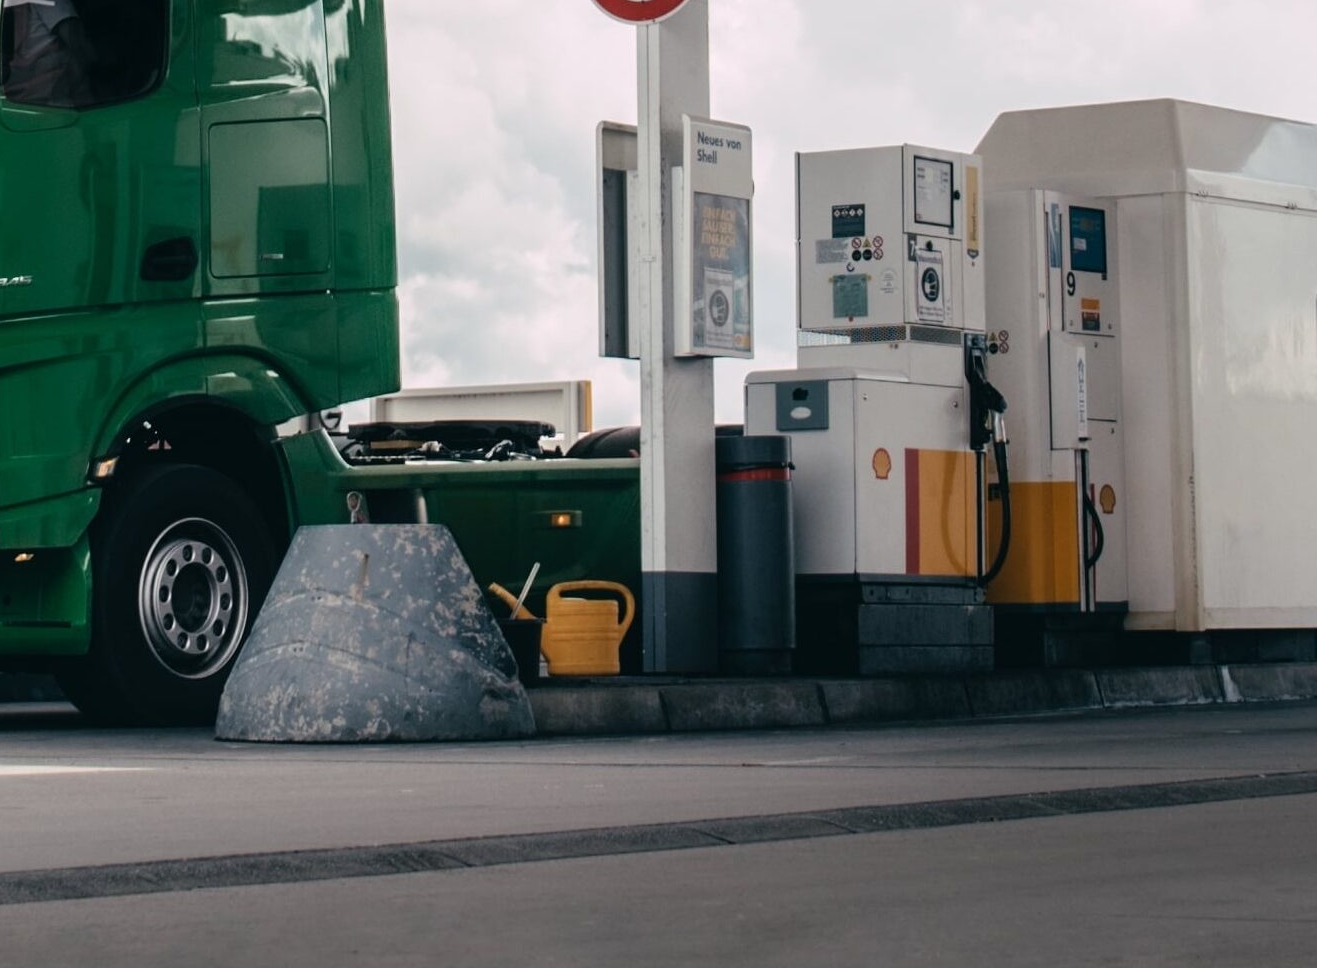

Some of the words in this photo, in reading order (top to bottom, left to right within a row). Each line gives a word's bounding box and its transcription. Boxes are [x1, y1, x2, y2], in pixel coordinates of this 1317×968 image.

[697, 131, 724, 147] Neues
[726, 138, 742, 150] von
[697, 148, 718, 164] Shell
[1066, 271, 1076, 296] 9
